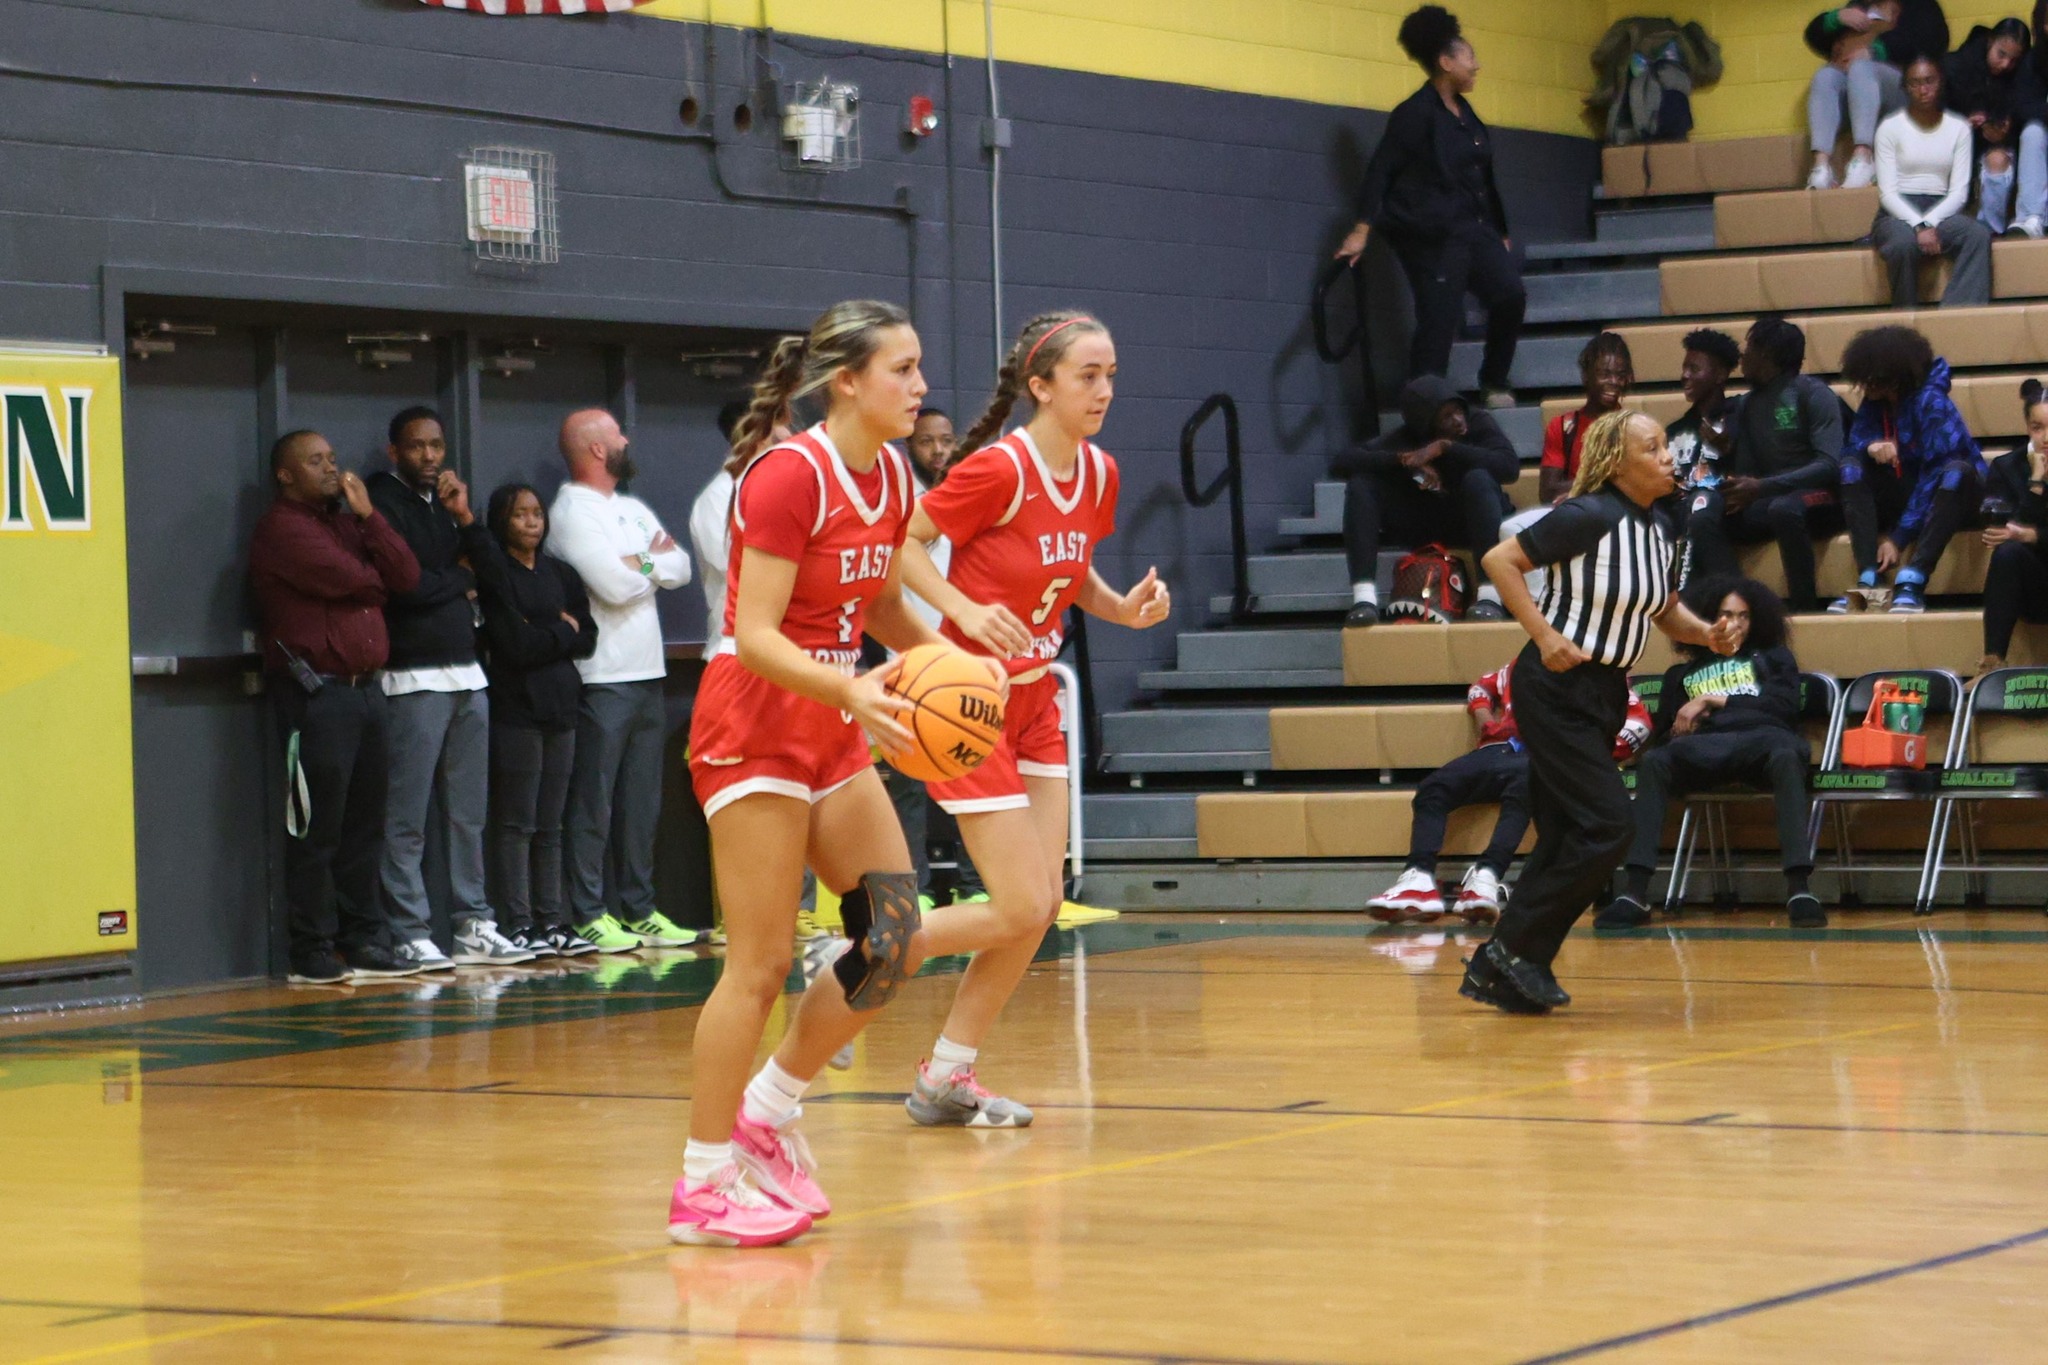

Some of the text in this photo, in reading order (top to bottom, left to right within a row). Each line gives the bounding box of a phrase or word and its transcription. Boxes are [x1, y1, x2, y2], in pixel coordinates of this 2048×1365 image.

[490, 177, 529, 229] EXIT
[0, 385, 93, 531] N
[839, 544, 894, 585] EAST
[1038, 531, 1087, 566] EAST
[1031, 577, 1072, 626] 5
[2003, 694, 2048, 710] ROWA
[2005, 675, 2048, 694] NORT
[1904, 740, 1917, 763] G
